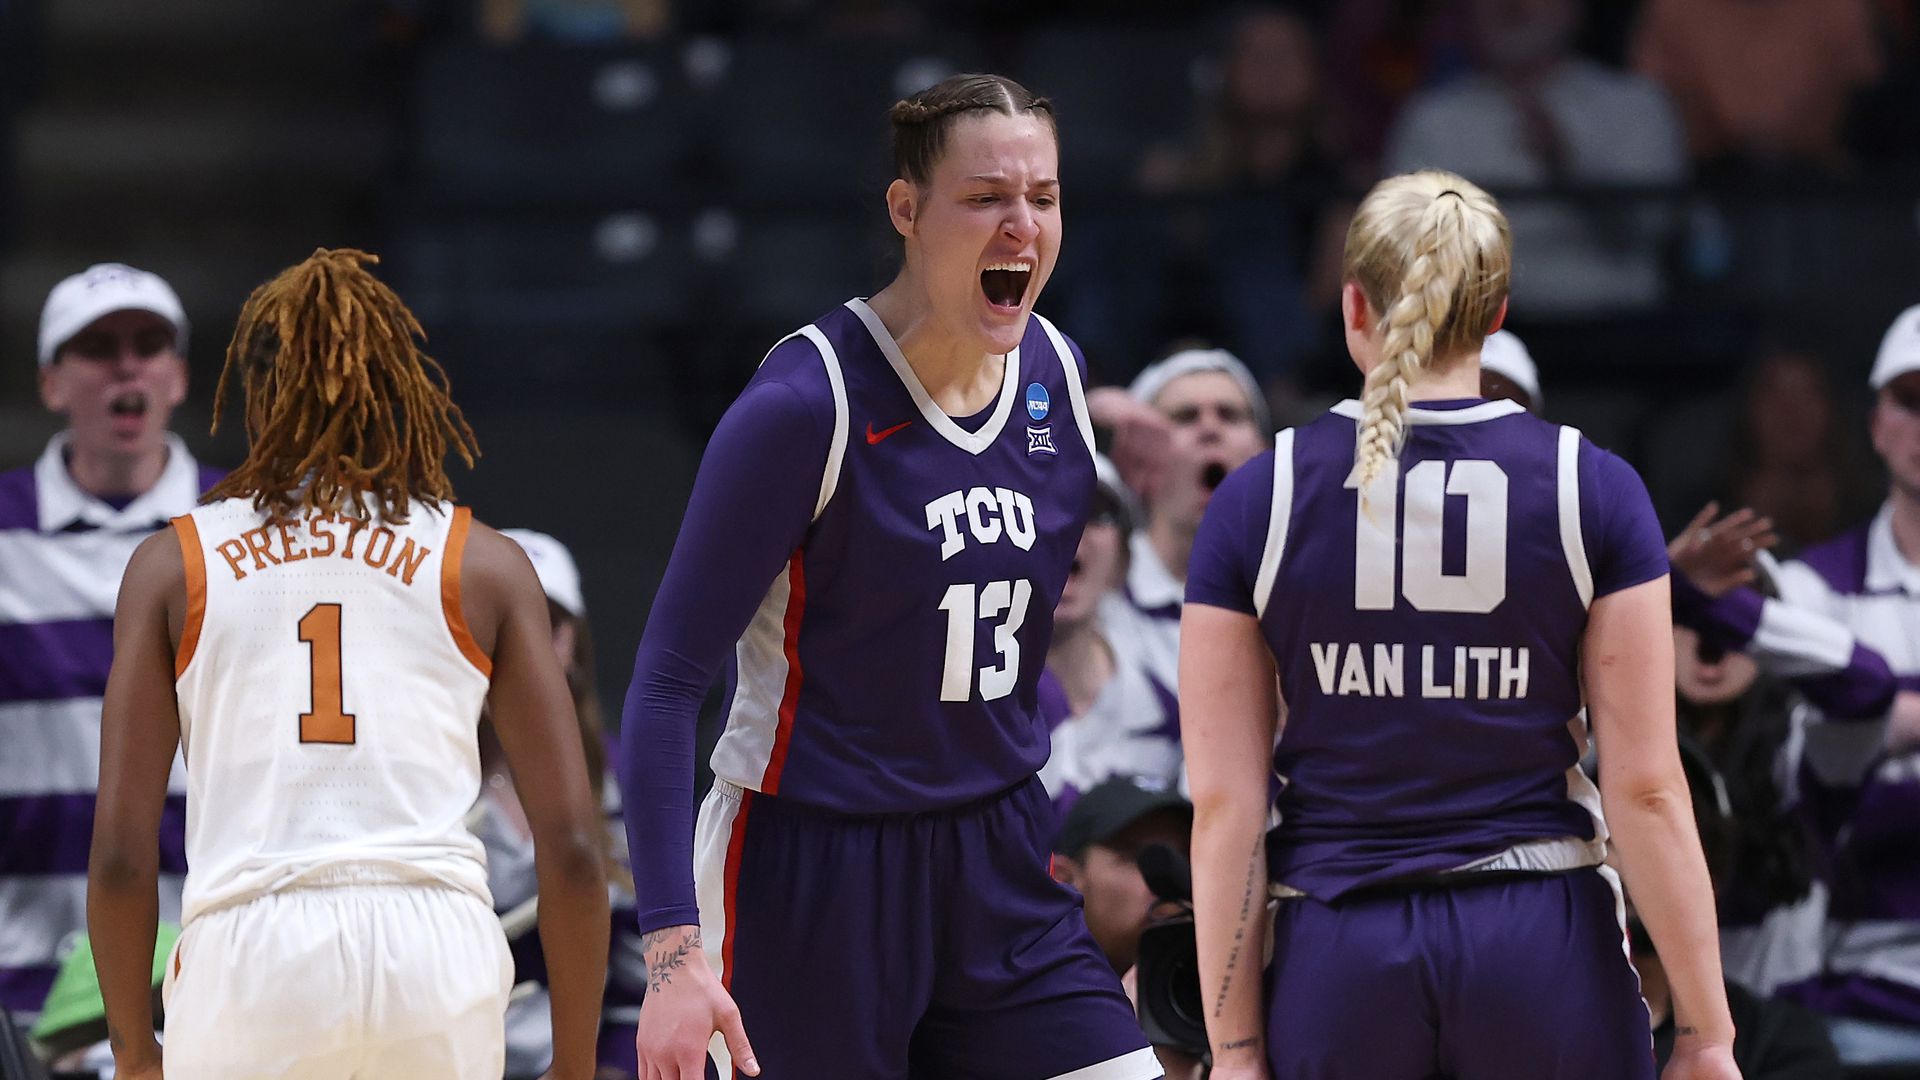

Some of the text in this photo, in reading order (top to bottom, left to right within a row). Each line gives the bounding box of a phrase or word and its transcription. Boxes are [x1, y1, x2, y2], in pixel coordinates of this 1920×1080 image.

[216, 513, 431, 586] PRESTON
[925, 487, 1036, 561] TCU
[1343, 460, 1508, 613] 10
[298, 603, 355, 744] 1
[938, 579, 1032, 701] 13
[1310, 643, 1529, 699] VAN LITH
